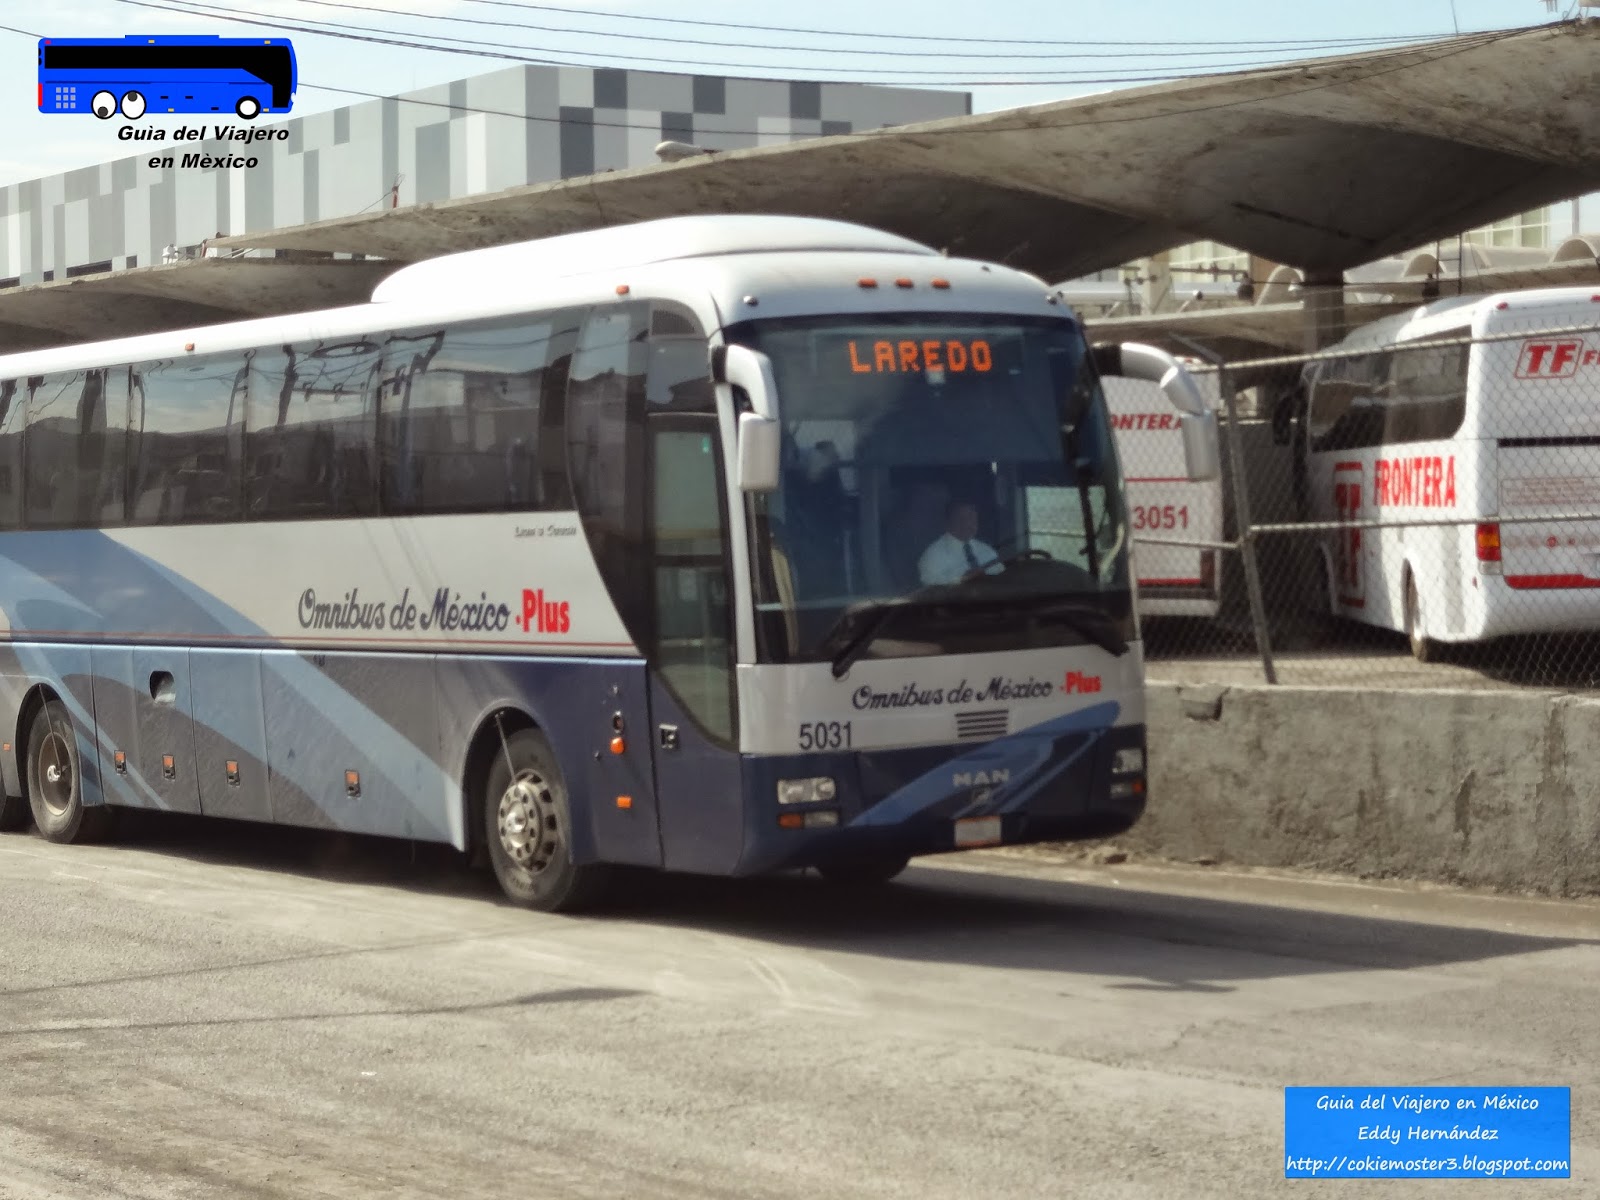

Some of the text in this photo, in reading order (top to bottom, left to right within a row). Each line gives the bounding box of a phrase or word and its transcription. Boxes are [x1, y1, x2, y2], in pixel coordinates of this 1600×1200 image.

[849, 340, 993, 373] LAREDO
[1527, 345, 1600, 373] TF F
[1374, 456, 1456, 507] FRONTERA
[1133, 505, 1189, 529] 3051
[298, 588, 386, 630] Omnibus
[390, 588, 417, 631] de
[419, 588, 512, 632] México
[852, 682, 945, 711] Omnibus
[947, 680, 974, 704] de
[975, 677, 1054, 702] México
[799, 721, 853, 751] 5031
[952, 768, 1011, 788] MAN
